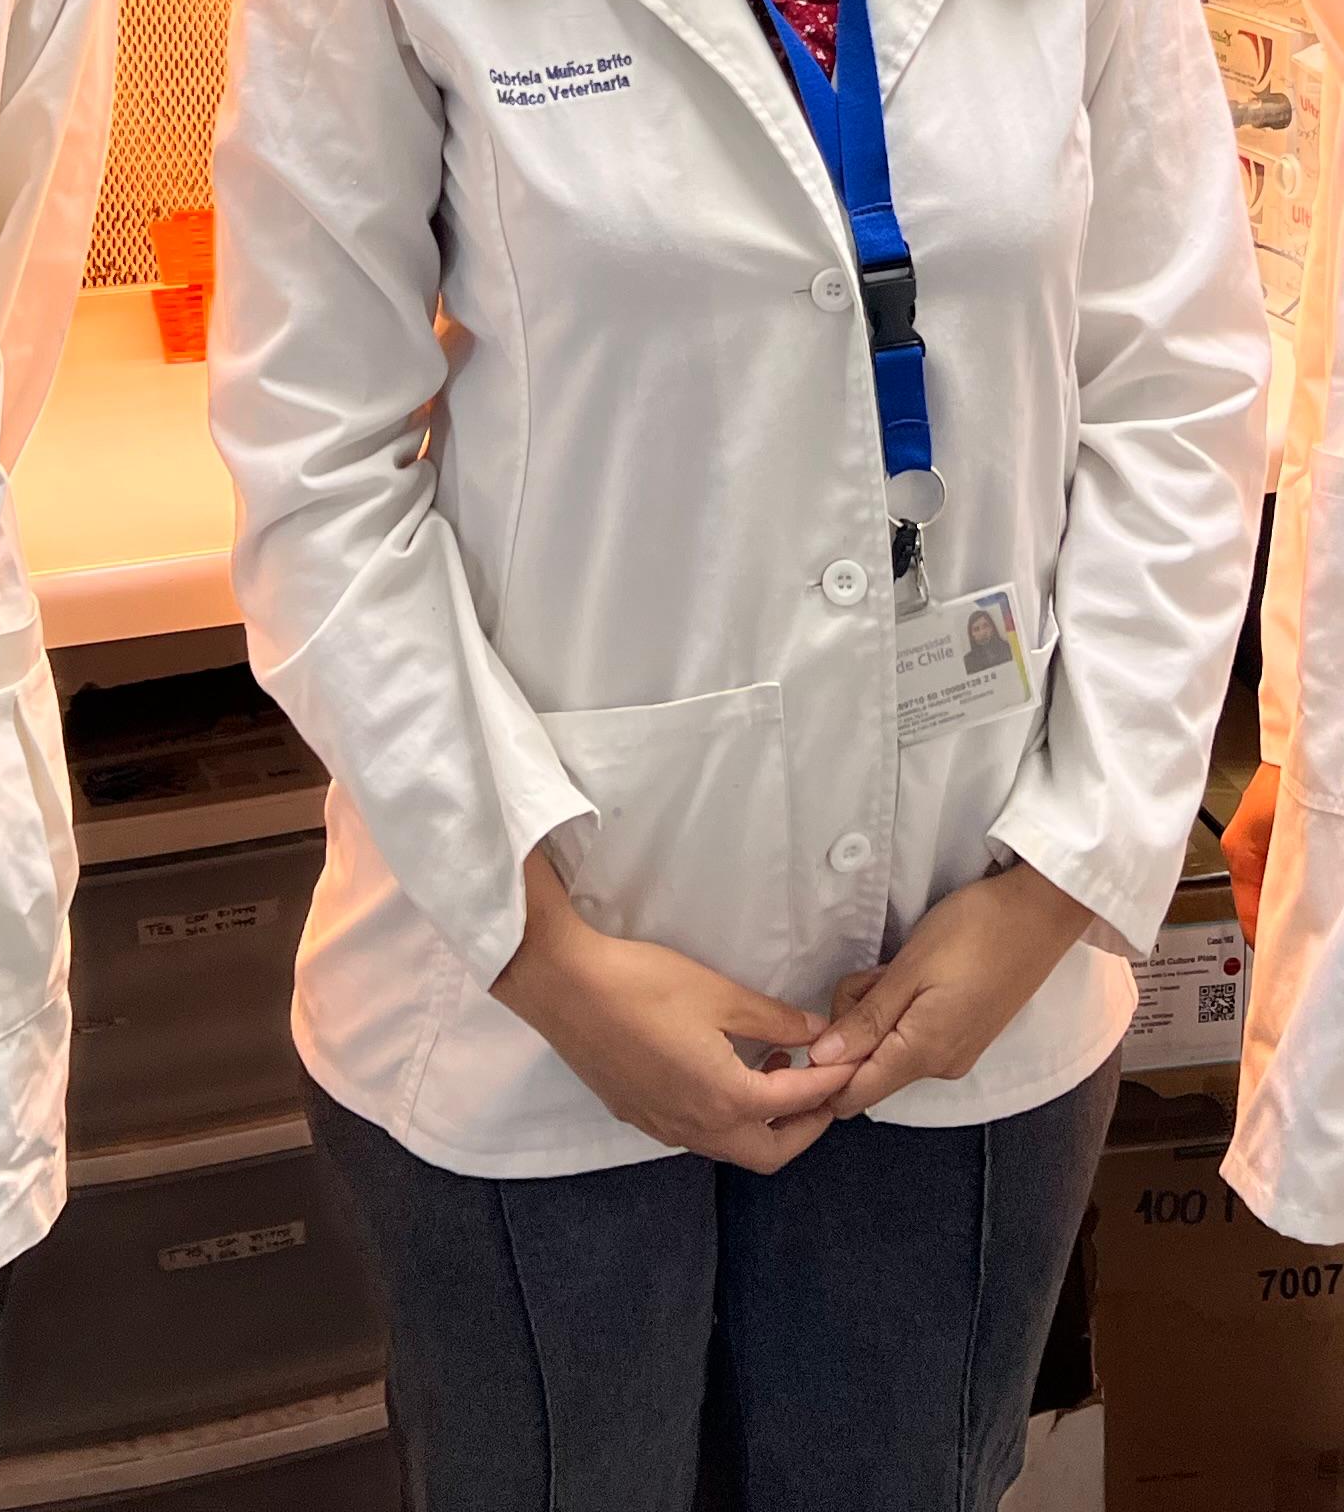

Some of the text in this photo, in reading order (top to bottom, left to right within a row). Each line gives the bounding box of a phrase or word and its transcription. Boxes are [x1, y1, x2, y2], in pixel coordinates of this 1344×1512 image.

[489, 52, 633, 87] Gabriela Muñoz Brito
[496, 73, 631, 106] Médico Veterinaria
[896, 648, 954, 674] de Chile
[1136, 1189, 1207, 1225] 100
